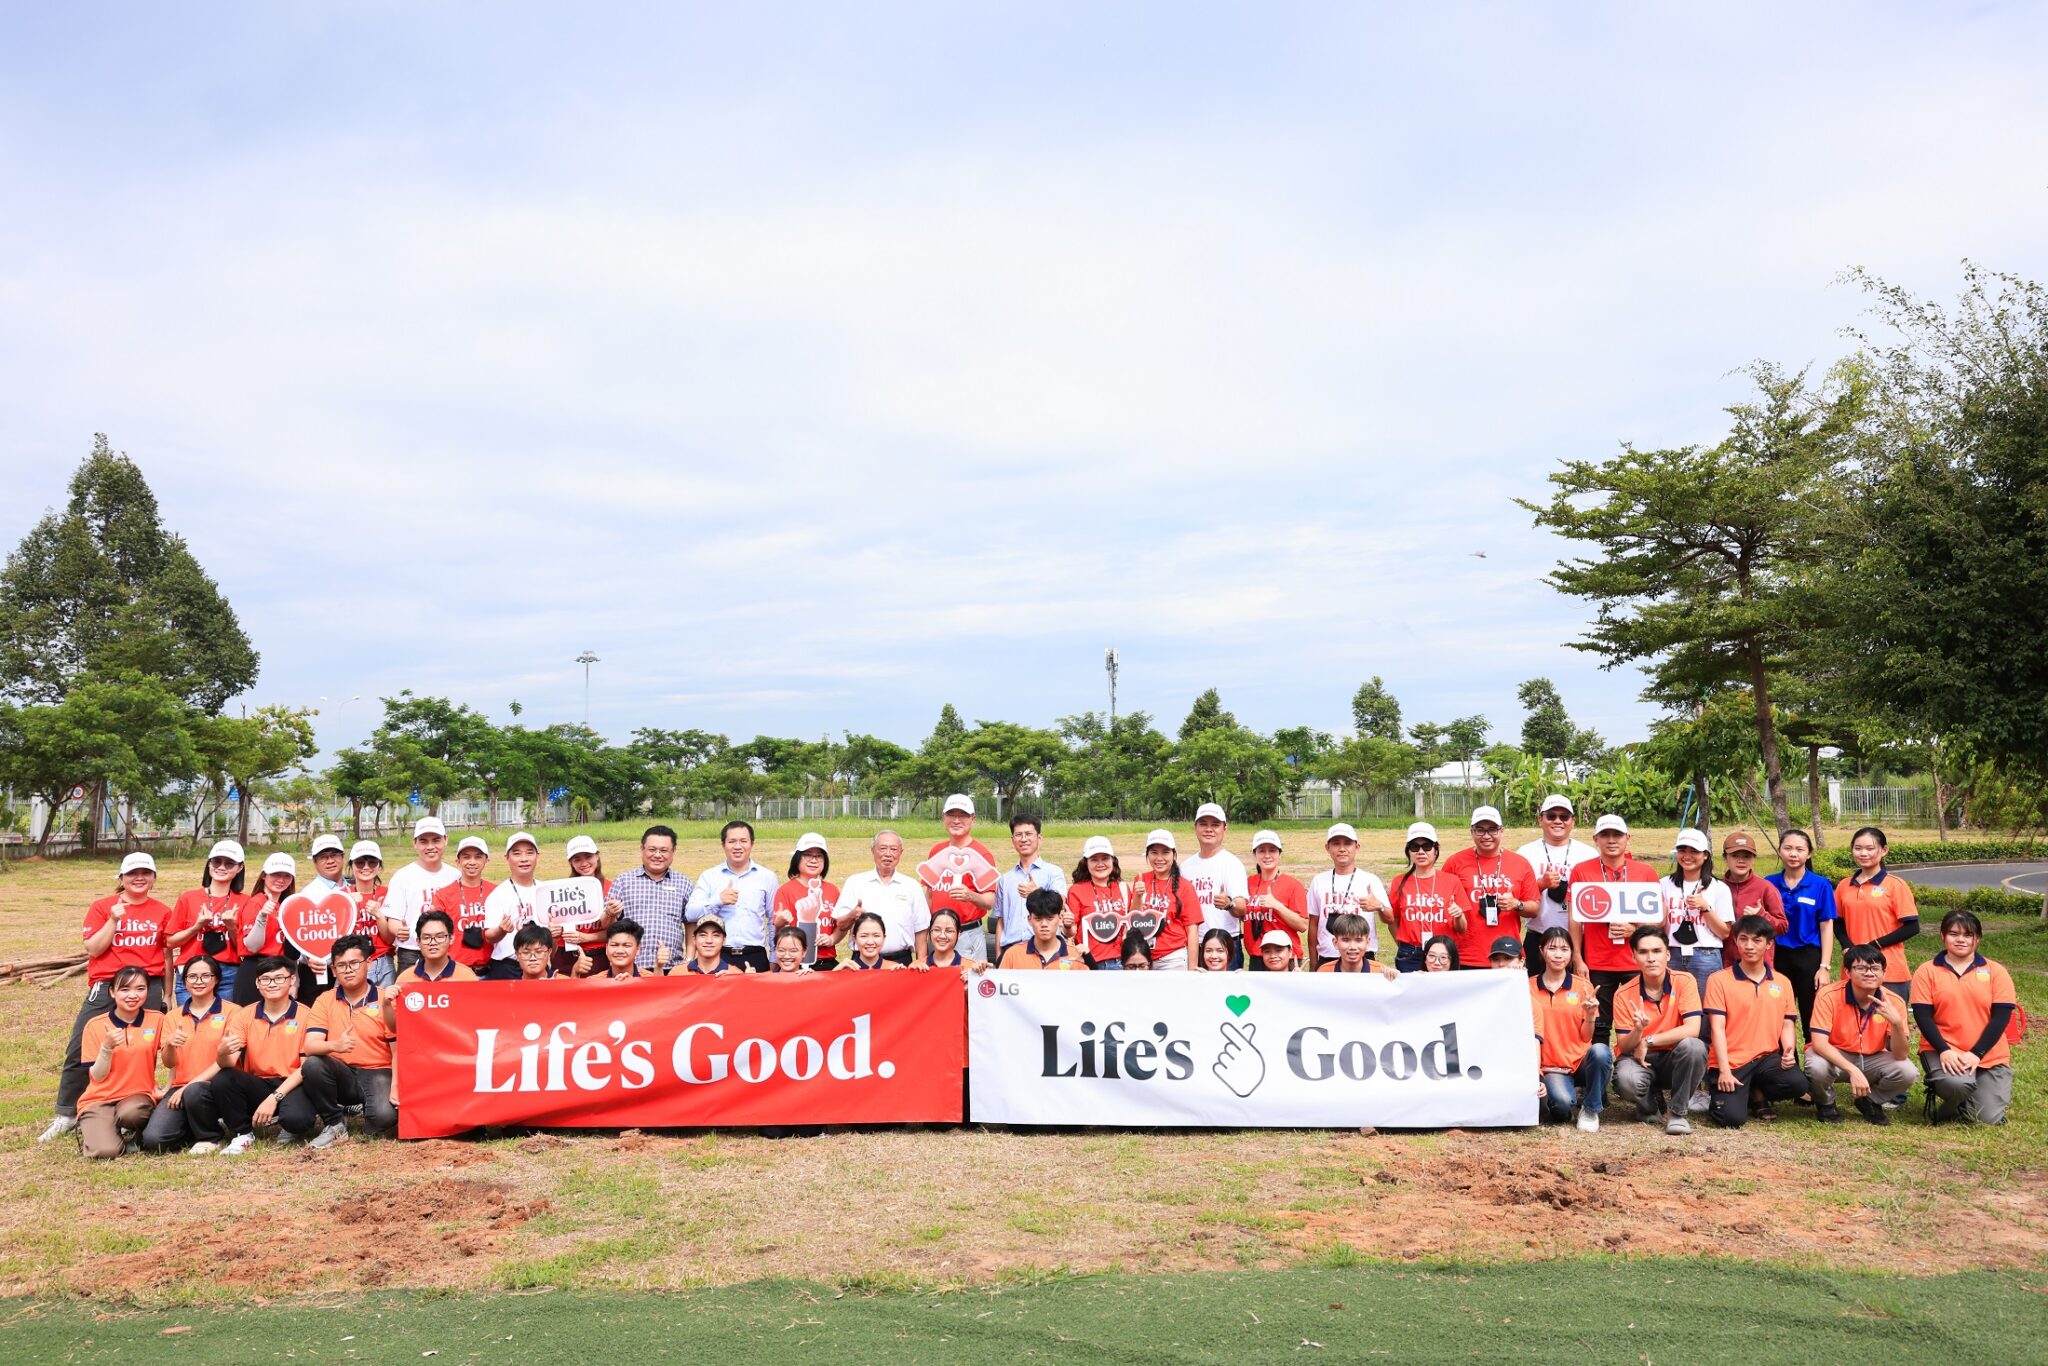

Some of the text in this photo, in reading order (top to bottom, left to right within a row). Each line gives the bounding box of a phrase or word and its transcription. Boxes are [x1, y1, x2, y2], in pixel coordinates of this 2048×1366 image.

[1473, 873, 1512, 888] Life's
[550, 886, 585, 904] Life's
[1406, 894, 1444, 907] Life's
[548, 901, 592, 918] Good.
[1619, 891, 1659, 915] LG
[299, 909, 337, 926] Life's
[1405, 908, 1448, 923] Good.
[117, 918, 158, 932] Life's
[1095, 920, 1115, 930] Life's
[1132, 919, 1156, 929] Good.
[297, 924, 342, 941] Good.
[1000, 983, 1019, 996] LG
[428, 994, 449, 1008] LG
[473, 1013, 896, 1093] Life's Good.
[1040, 1020, 1483, 1081] Life's Good.
